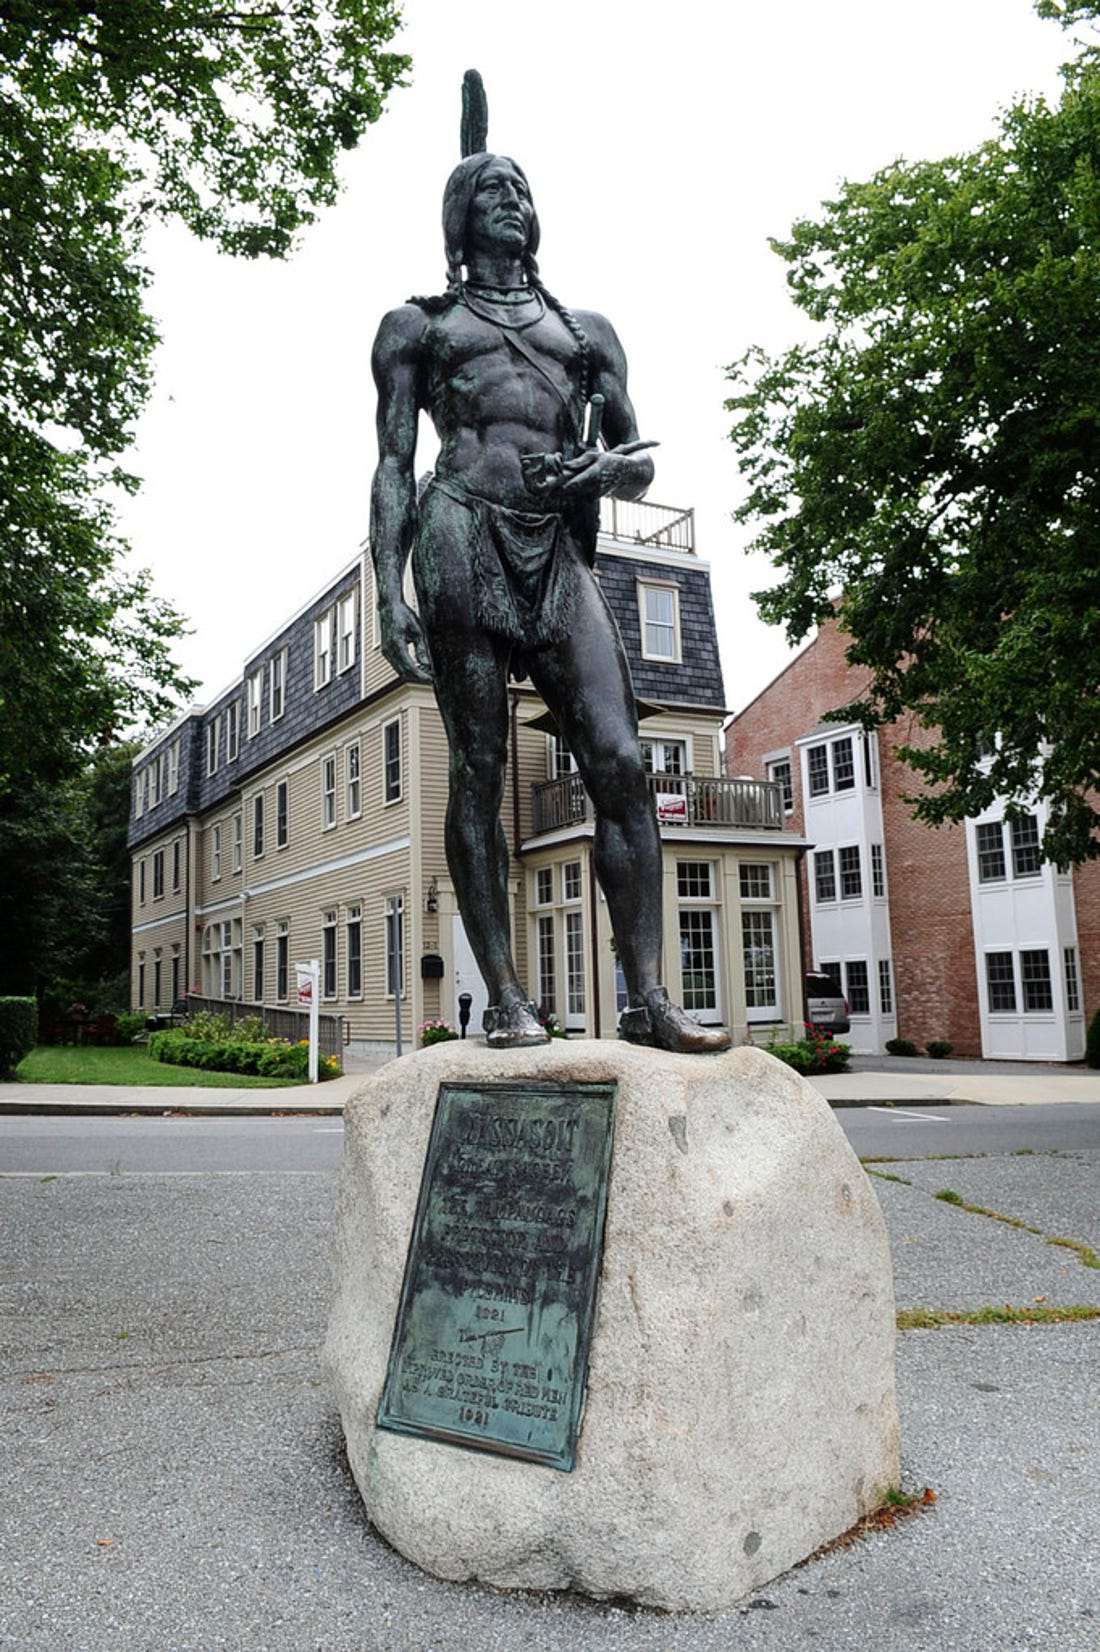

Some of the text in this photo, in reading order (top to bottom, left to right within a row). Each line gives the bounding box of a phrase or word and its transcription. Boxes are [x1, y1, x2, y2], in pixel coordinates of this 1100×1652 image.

[430, 1348, 537, 1380] ERECTED BY THE
[514, 1383, 540, 1399] RED
[541, 1386, 569, 1405] MEN
[502, 1397, 558, 1422] TRIBUTE
